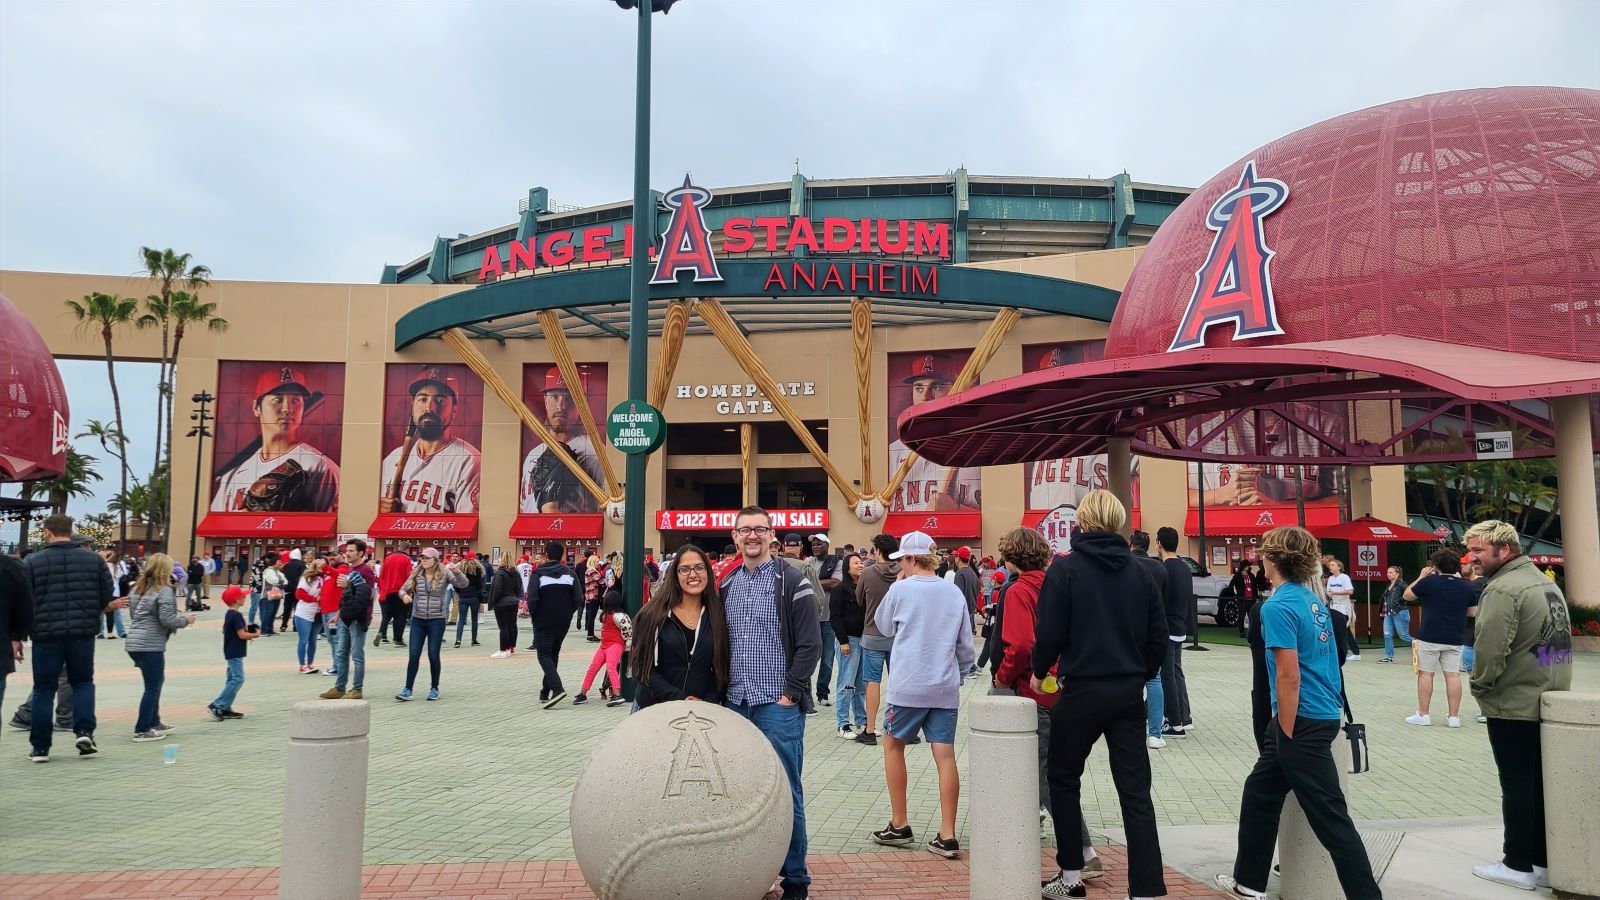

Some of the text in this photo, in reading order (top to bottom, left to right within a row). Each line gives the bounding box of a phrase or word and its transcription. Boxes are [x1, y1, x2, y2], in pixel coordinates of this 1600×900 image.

[722, 215, 950, 258] STADIUM
[763, 262, 938, 295] ANAHEIM
[676, 382, 815, 399] HOMEPATE
[716, 400, 773, 415] GATE
[612, 413, 653, 423] WELCOME
[619, 428, 645, 437] ANGEL
[613, 437, 650, 447] STADIUM
[1034, 458, 1108, 490] NGELS
[676, 513, 706, 527] 2022
[710, 513, 738, 527] TICK
[772, 513, 786, 526] ON
[790, 513, 823, 526] SALE
